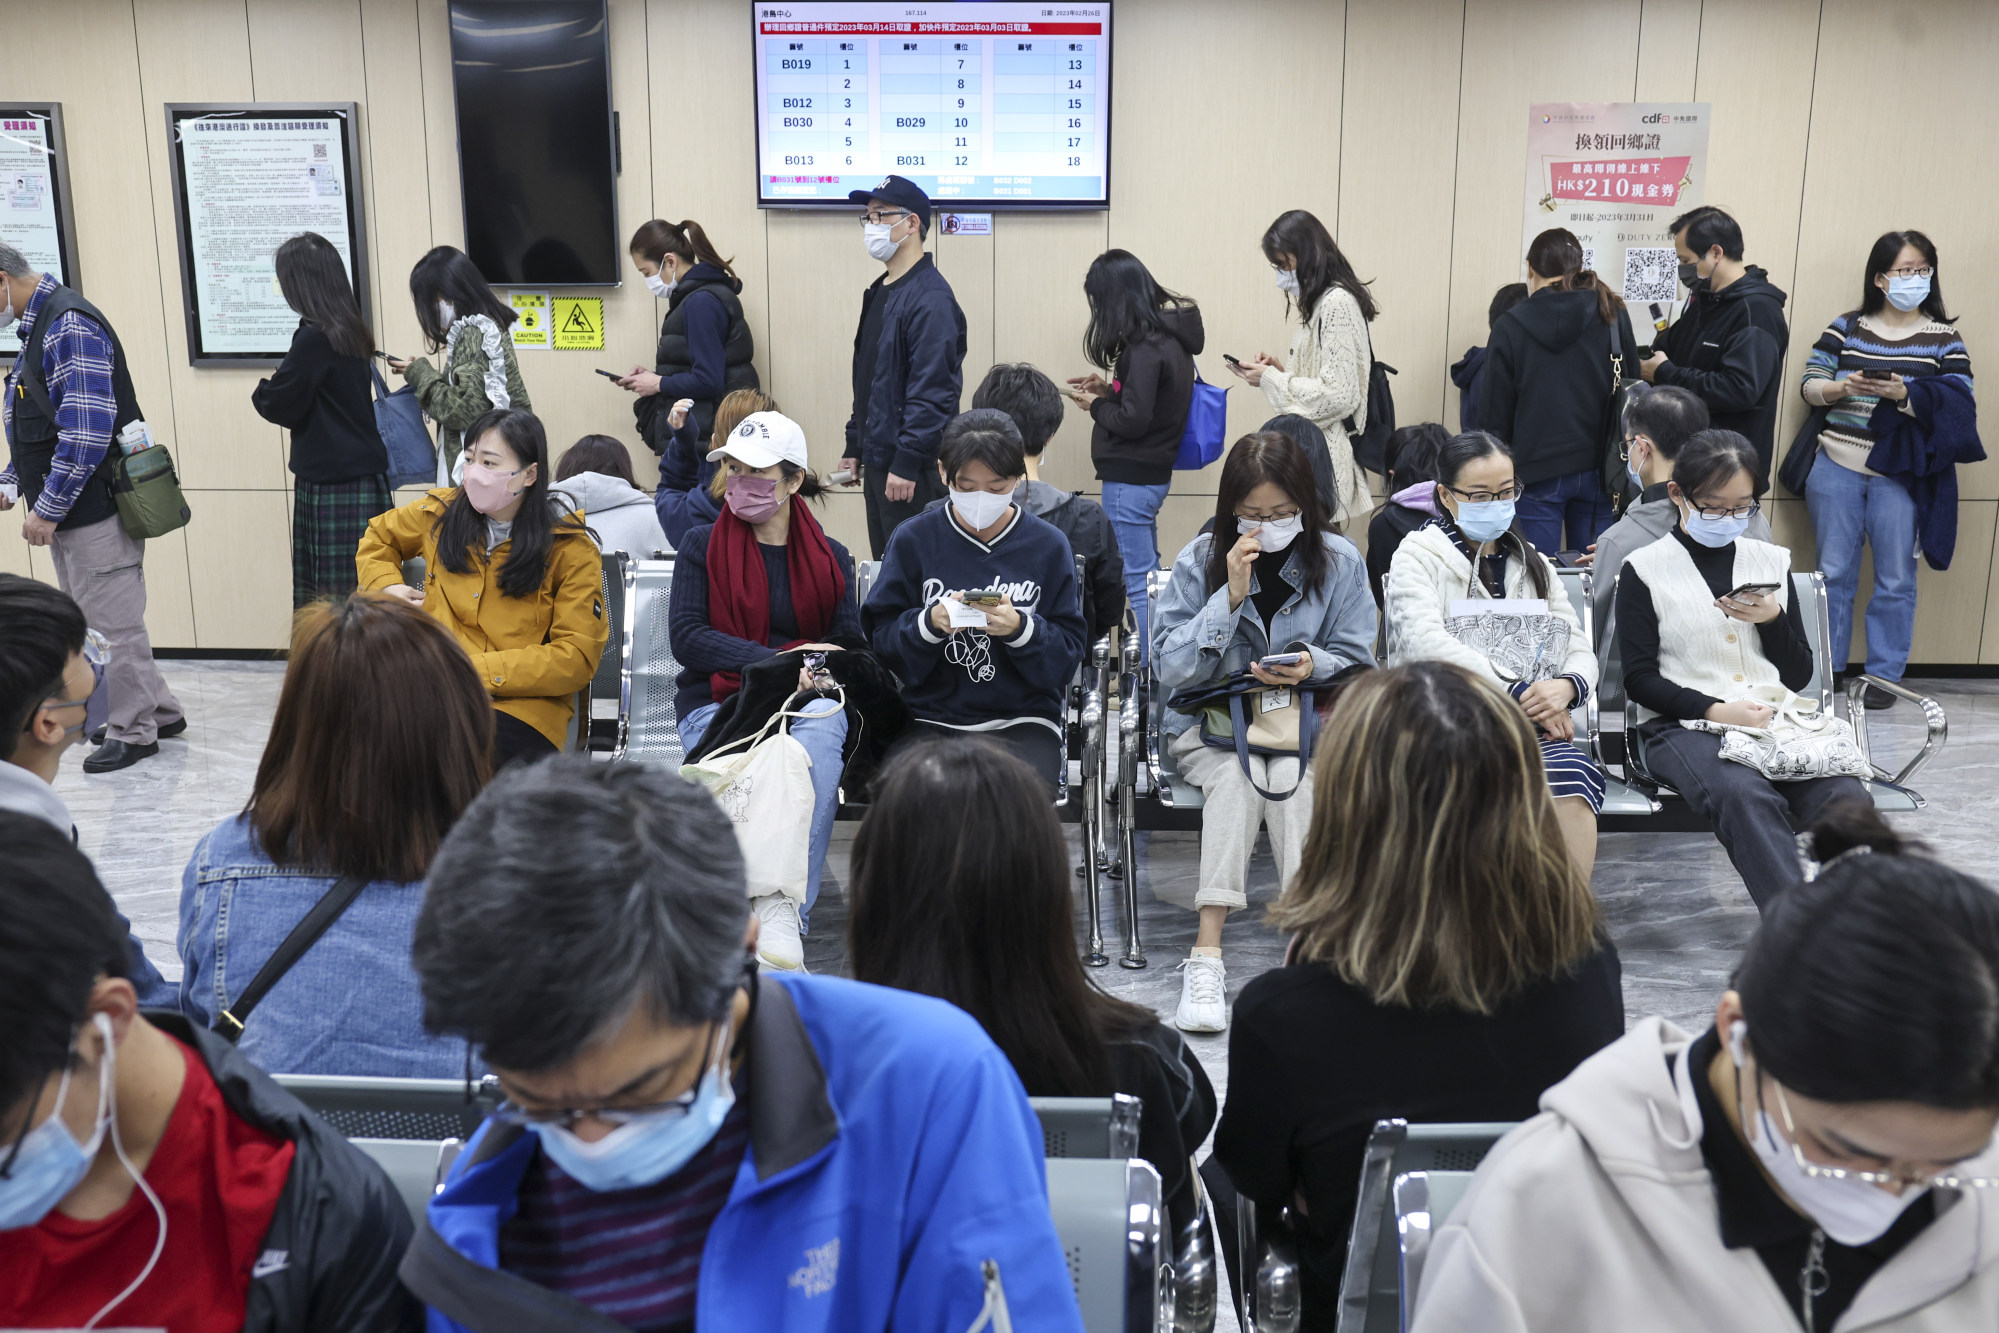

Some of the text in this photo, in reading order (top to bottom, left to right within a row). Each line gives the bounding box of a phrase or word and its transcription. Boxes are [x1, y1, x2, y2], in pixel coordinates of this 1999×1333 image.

[761, 9, 792, 18] 港島中心
[782, 60, 850, 70] B019 1
[957, 60, 964, 69] 7
[1068, 60, 1081, 69] 13
[844, 79, 850, 88] 2
[957, 79, 964, 89] 8
[1068, 80, 1081, 89] 14
[783, 98, 851, 108] B012 3
[957, 99, 964, 108] 9
[1068, 99, 1081, 108] 15
[783, 118, 851, 127] B030 4
[896, 118, 967, 127] B029 10
[1642, 113, 1662, 124] cdf
[4, 121, 36, 131] 受理須知
[1068, 119, 1081, 128] 16
[845, 137, 851, 146] 5
[955, 138, 967, 146] 11
[1067, 138, 1080, 147] 17
[1575, 133, 1661, 151] 換領回鄉證
[784, 156, 852, 165] B013 6
[896, 156, 967, 165] B031 12
[1068, 157, 1080, 166] 18
[1572, 163, 1661, 174] 最高即得線上線下
[1570, 213, 1654, 221] 即日起-2023年3月31日
[922, 575, 1041, 611] Padena
